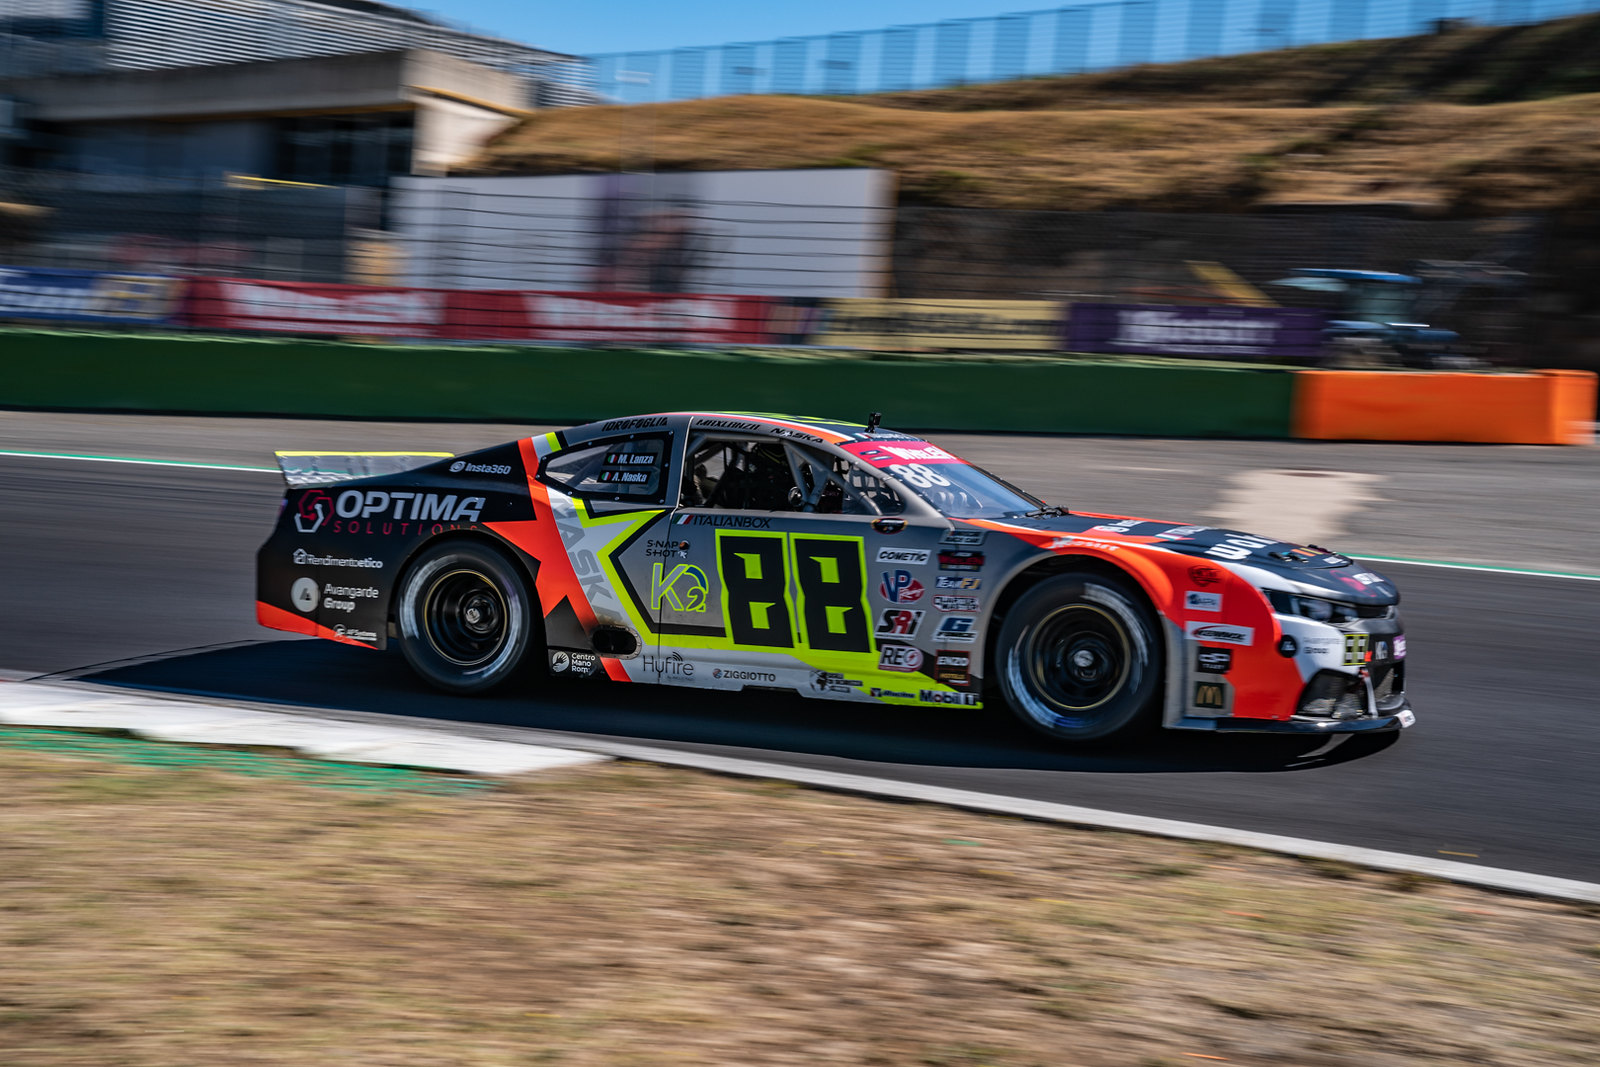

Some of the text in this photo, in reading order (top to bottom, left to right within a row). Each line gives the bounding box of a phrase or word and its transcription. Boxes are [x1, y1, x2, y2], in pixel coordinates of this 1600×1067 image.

[601, 416, 668, 432] IDROFOGLIA
[617, 453, 654, 464] M. Lanza
[465, 462, 512, 475] Insta360
[889, 462, 951, 489] 88
[611, 471, 648, 483] A. Naska
[335, 489, 486, 522] OPTIMA
[693, 515, 771, 529] ITALIANBOX
[879, 551, 928, 562] COMETIC
[323, 583, 380, 598] Avangarde
[714, 528, 876, 653] 88
[882, 569, 912, 602] VP
[323, 597, 356, 613] Group
[571, 653, 596, 661] Centro
[571, 660, 592, 668] Mano
[571, 667, 592, 675] Rom
[723, 671, 776, 682] ZIGGIOTTO
[919, 689, 961, 705] Mobil
